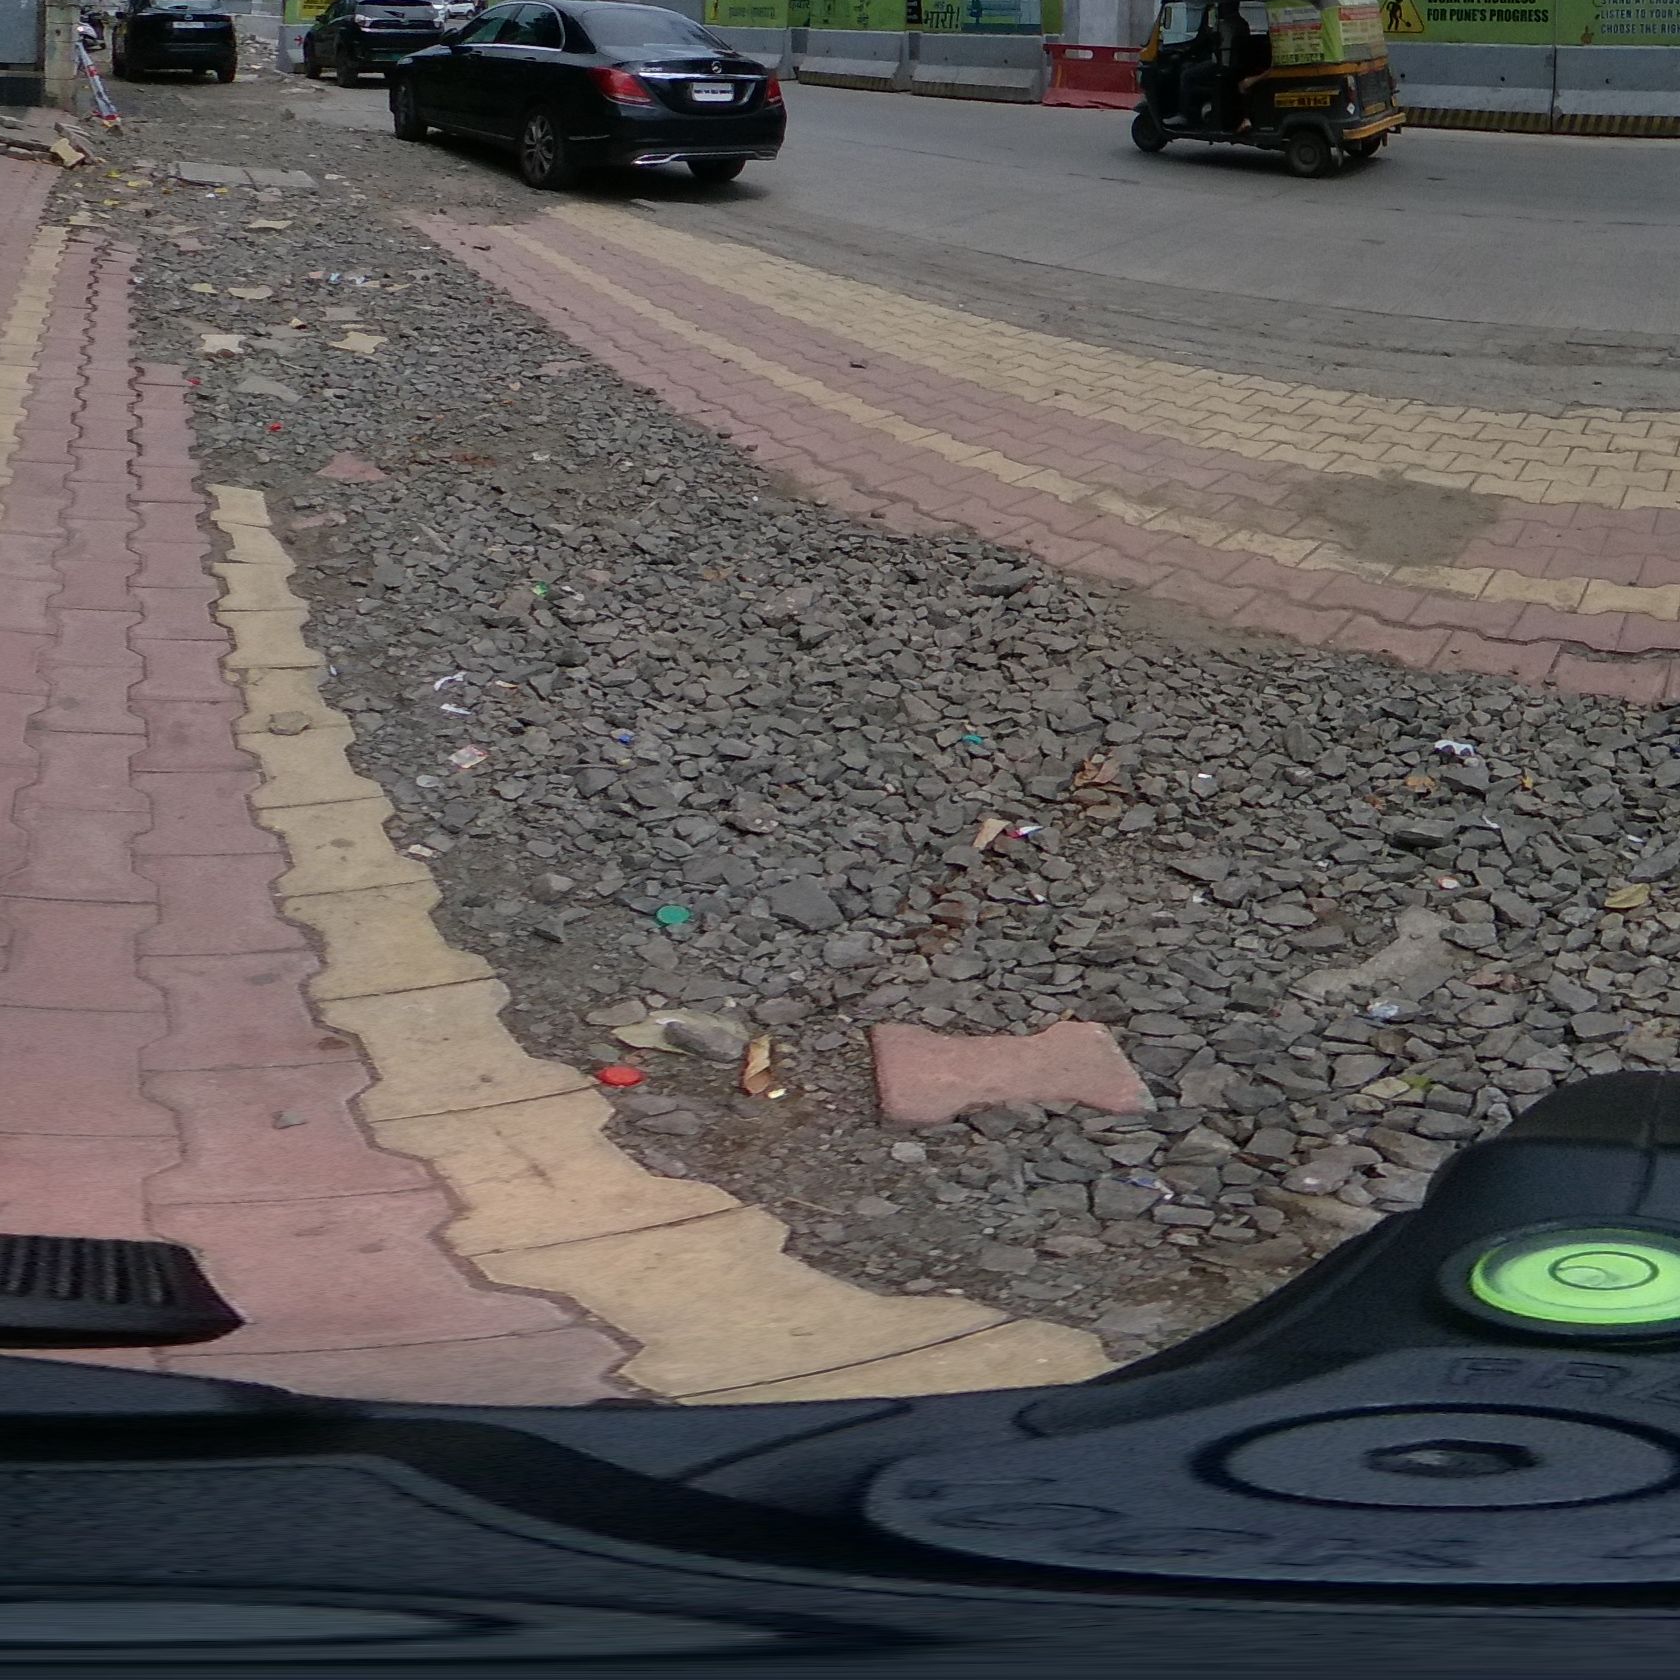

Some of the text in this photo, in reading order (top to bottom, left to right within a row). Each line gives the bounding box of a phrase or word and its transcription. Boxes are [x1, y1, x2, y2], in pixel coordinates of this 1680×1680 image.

[1427, 8, 1550, 23] FOR PUNE'S PROGRESS
[1600, 9, 1673, 19] LISTEN TO YOUR
[1600, 24, 1636, 34] CHOOSE
[1640, 23, 1657, 34] THE
